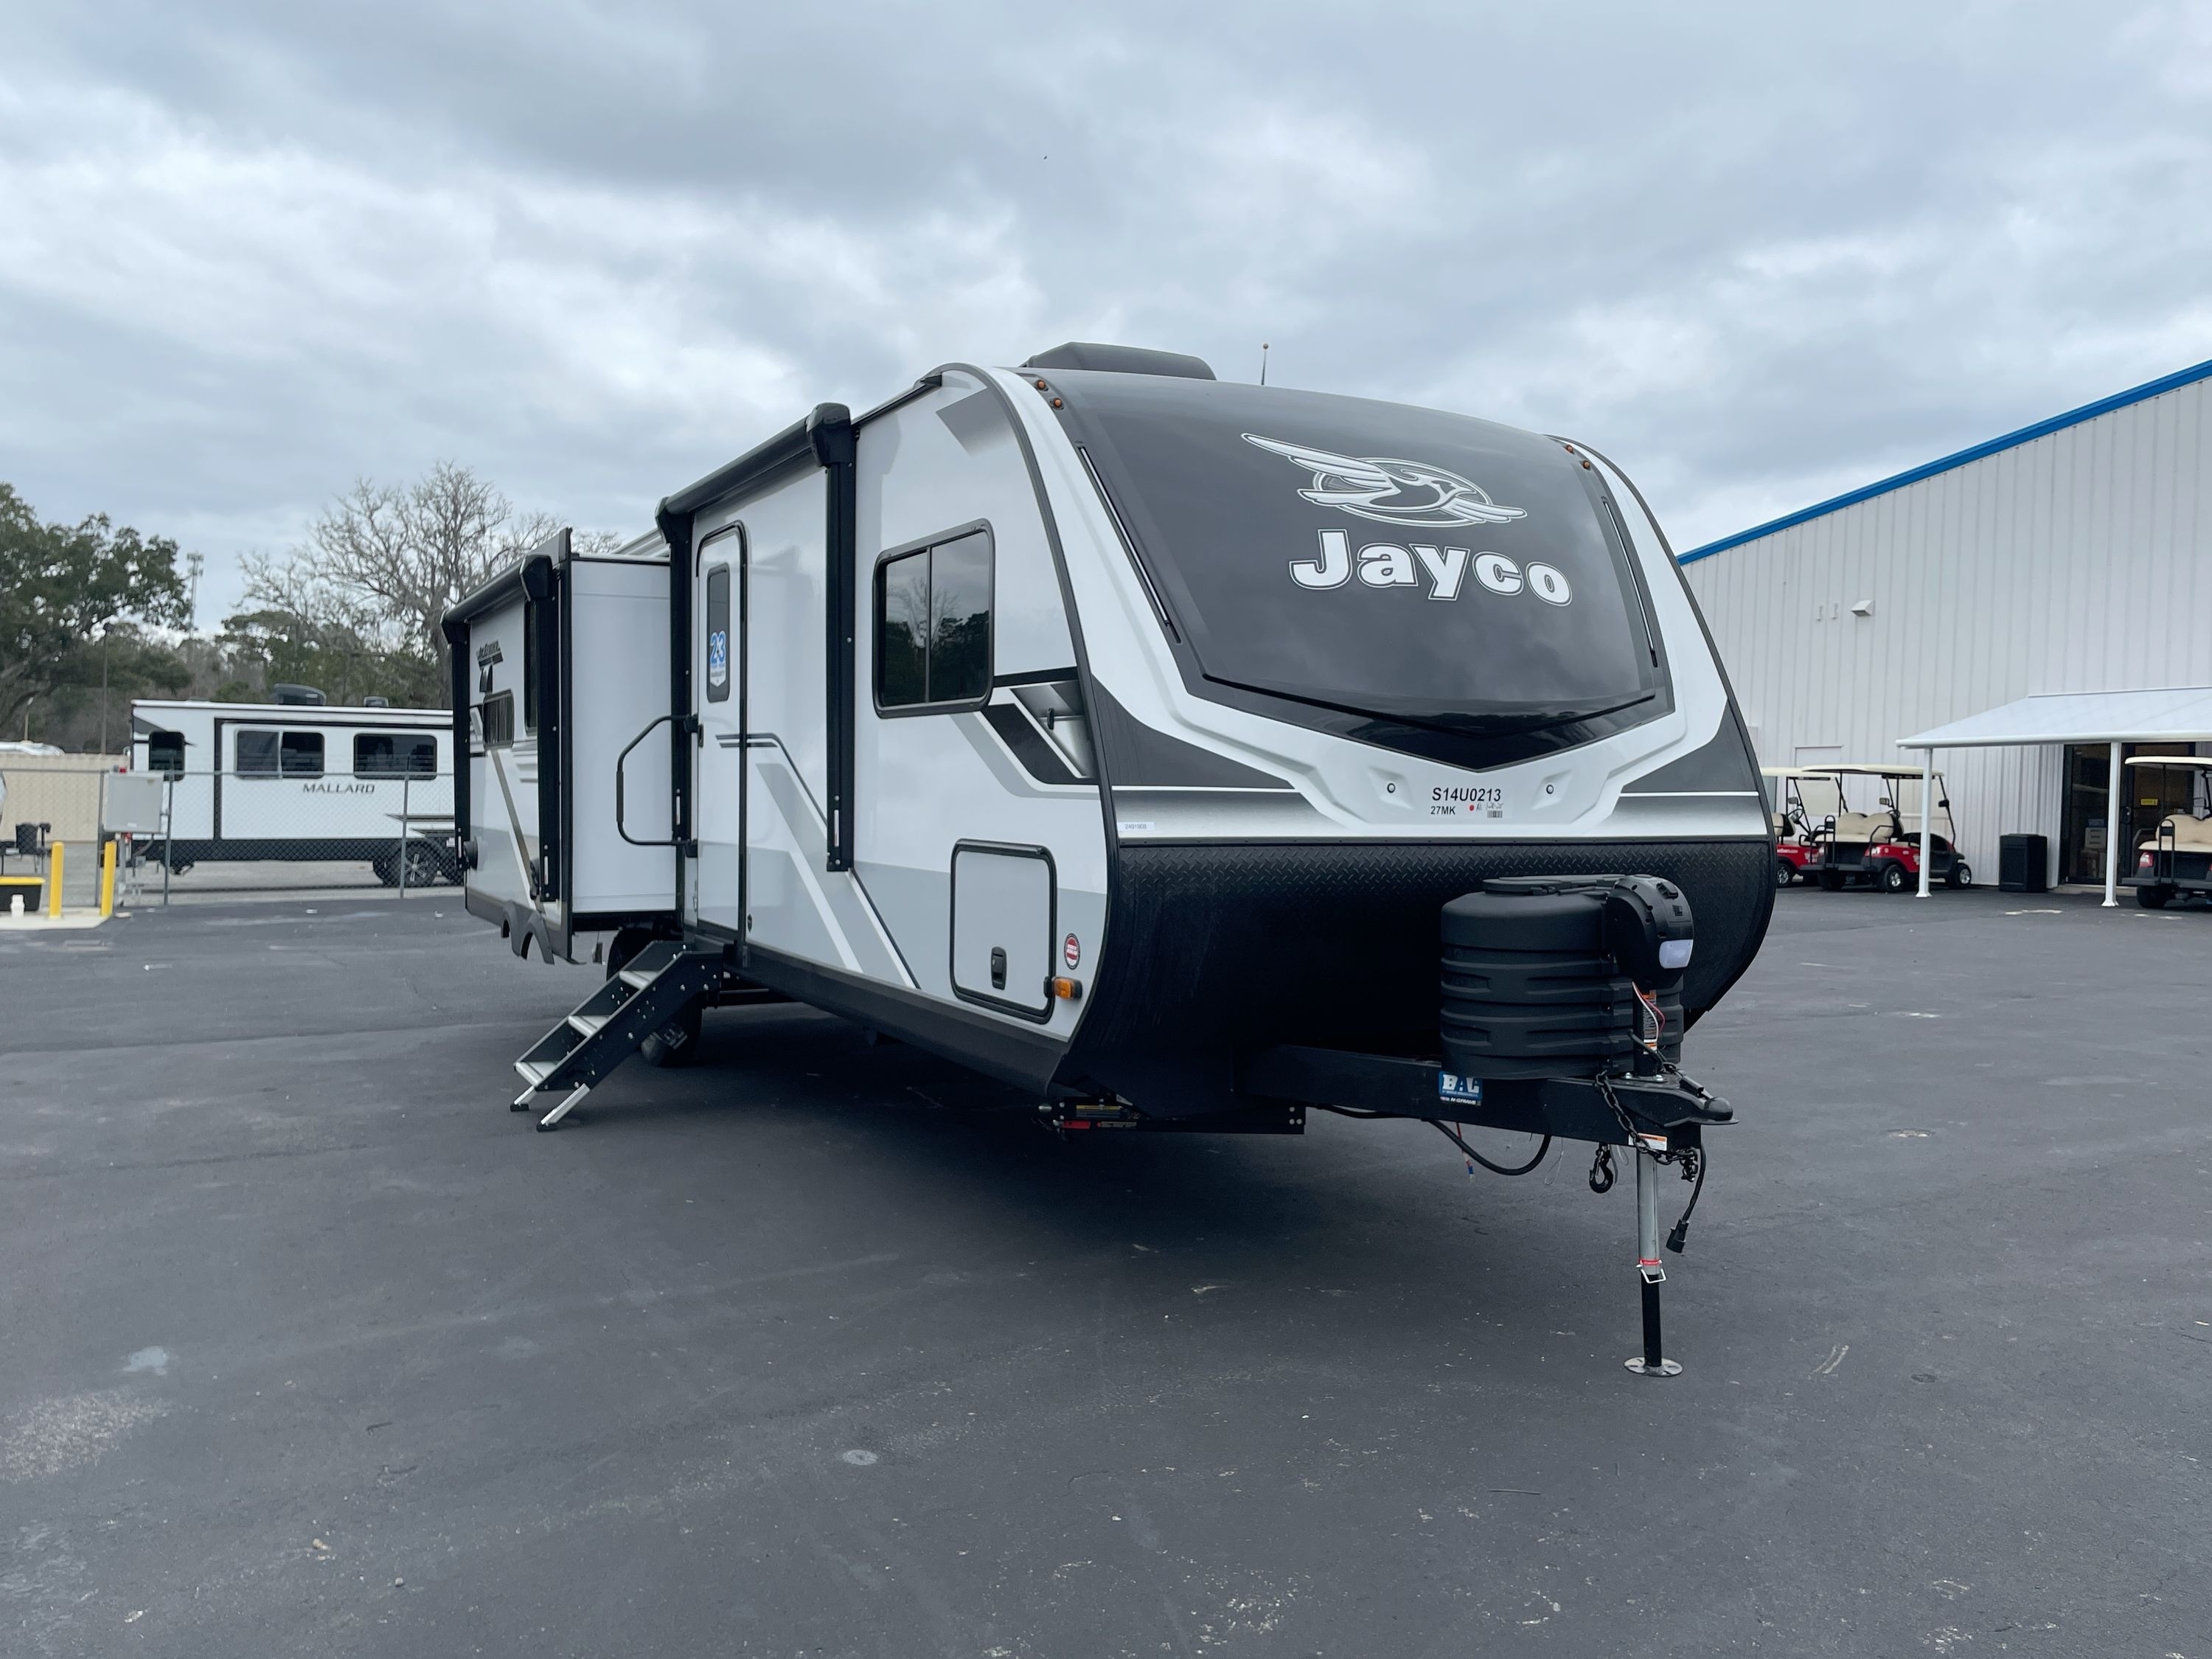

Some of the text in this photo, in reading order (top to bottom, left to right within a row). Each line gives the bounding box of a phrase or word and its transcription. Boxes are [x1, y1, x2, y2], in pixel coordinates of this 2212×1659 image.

[1289, 529, 1573, 607] Jayco
[303, 783, 375, 794] MALLARD
[1432, 787, 1501, 801] S14U0213
[1430, 805, 1456, 815] 27MK
